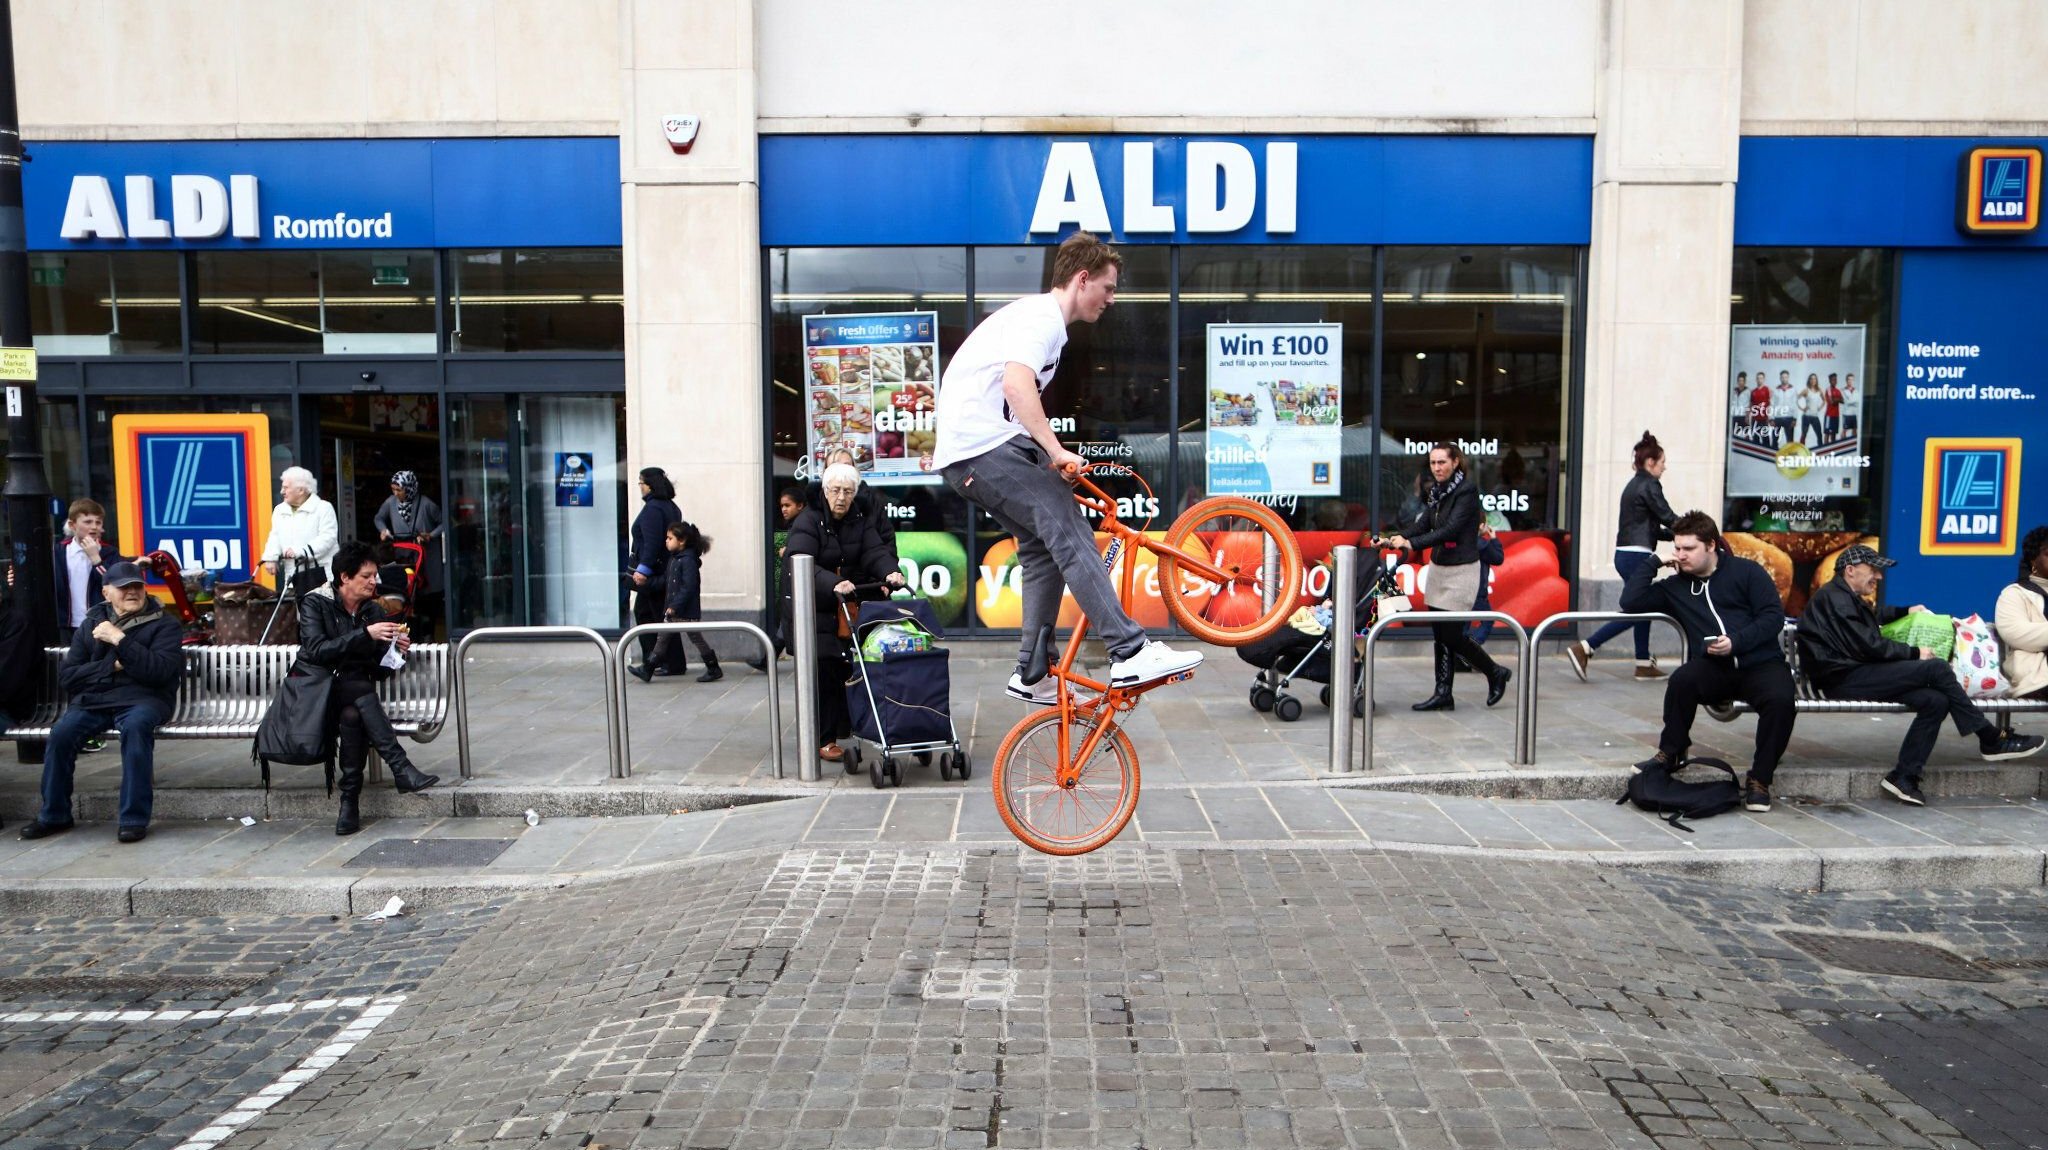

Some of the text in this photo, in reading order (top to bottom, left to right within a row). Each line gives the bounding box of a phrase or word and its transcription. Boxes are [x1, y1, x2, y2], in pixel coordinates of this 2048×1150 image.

[1029, 142, 1298, 233] ALDI
[60, 174, 393, 239] ALDI Romford
[1983, 202, 2024, 216] ALDI
[838, 326, 866, 336] Fresh
[868, 323, 900, 335] Offers
[1220, 333, 1329, 356] Win £100
[1759, 336, 1838, 348] Winning quality.
[1907, 341, 1980, 358] Welcome
[1219, 359, 1234, 367] and
[1235, 359, 1246, 367] fill
[1247, 360, 1258, 368] up
[1289, 359, 1330, 367] favourites.
[1761, 350, 1836, 361] Amazing value.
[17, 368, 31, 376] Only
[1906, 364, 1967, 382] to your
[1906, 384, 2036, 400] Romford store...
[875, 404, 938, 432] dair
[1303, 402, 1335, 419] beer,
[1078, 441, 1134, 456] biscuits
[1093, 461, 1134, 476] cakes
[884, 503, 917, 518] hes
[1941, 514, 1998, 534] ALDI
[157, 539, 242, 570] ALDI
